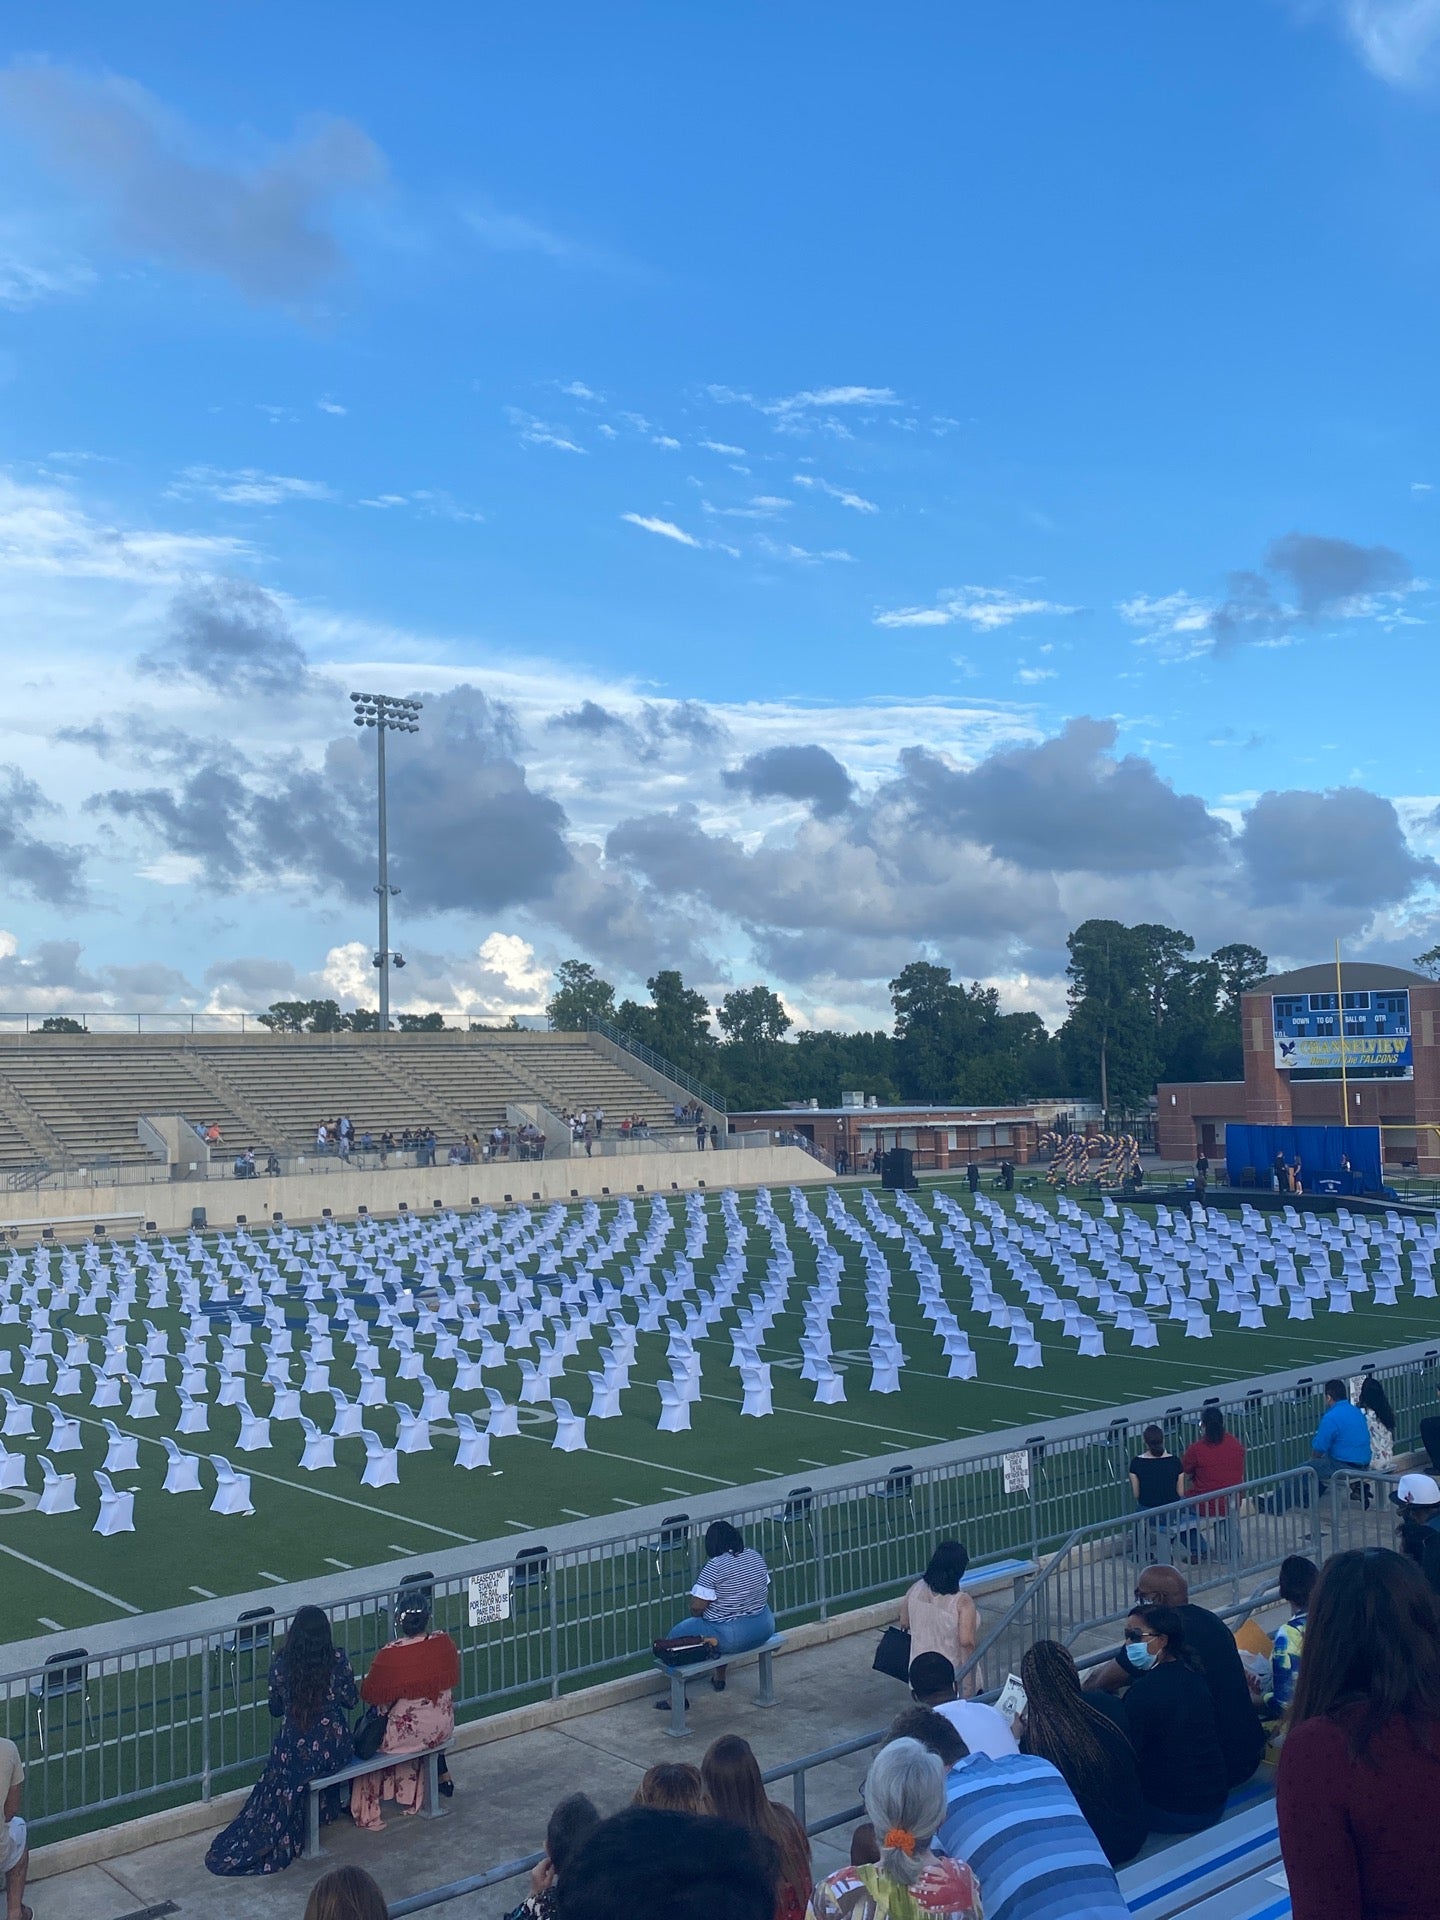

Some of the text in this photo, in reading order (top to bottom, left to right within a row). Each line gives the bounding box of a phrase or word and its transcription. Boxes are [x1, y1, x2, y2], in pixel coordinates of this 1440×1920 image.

[1292, 1017, 1310, 1025] DOWN
[1325, 1016, 1334, 1024] GO
[1345, 1015, 1358, 1023] BALL
[1374, 1014, 1387, 1022] QTR
[1300, 1037, 1409, 1055] CHANNELVIEW
[1311, 1056, 1330, 1066] Home
[1345, 1055, 1358, 1065] the
[1360, 1054, 1399, 1064] FALCONS
[497, 1570, 506, 1579] NOT
[478, 1581, 493, 1592] STAND
[479, 1588, 499, 1600] THE RAIL
[470, 1600, 479, 1610] POR
[480, 1597, 494, 1608] FAVOR
[477, 1606, 488, 1616] PARE
